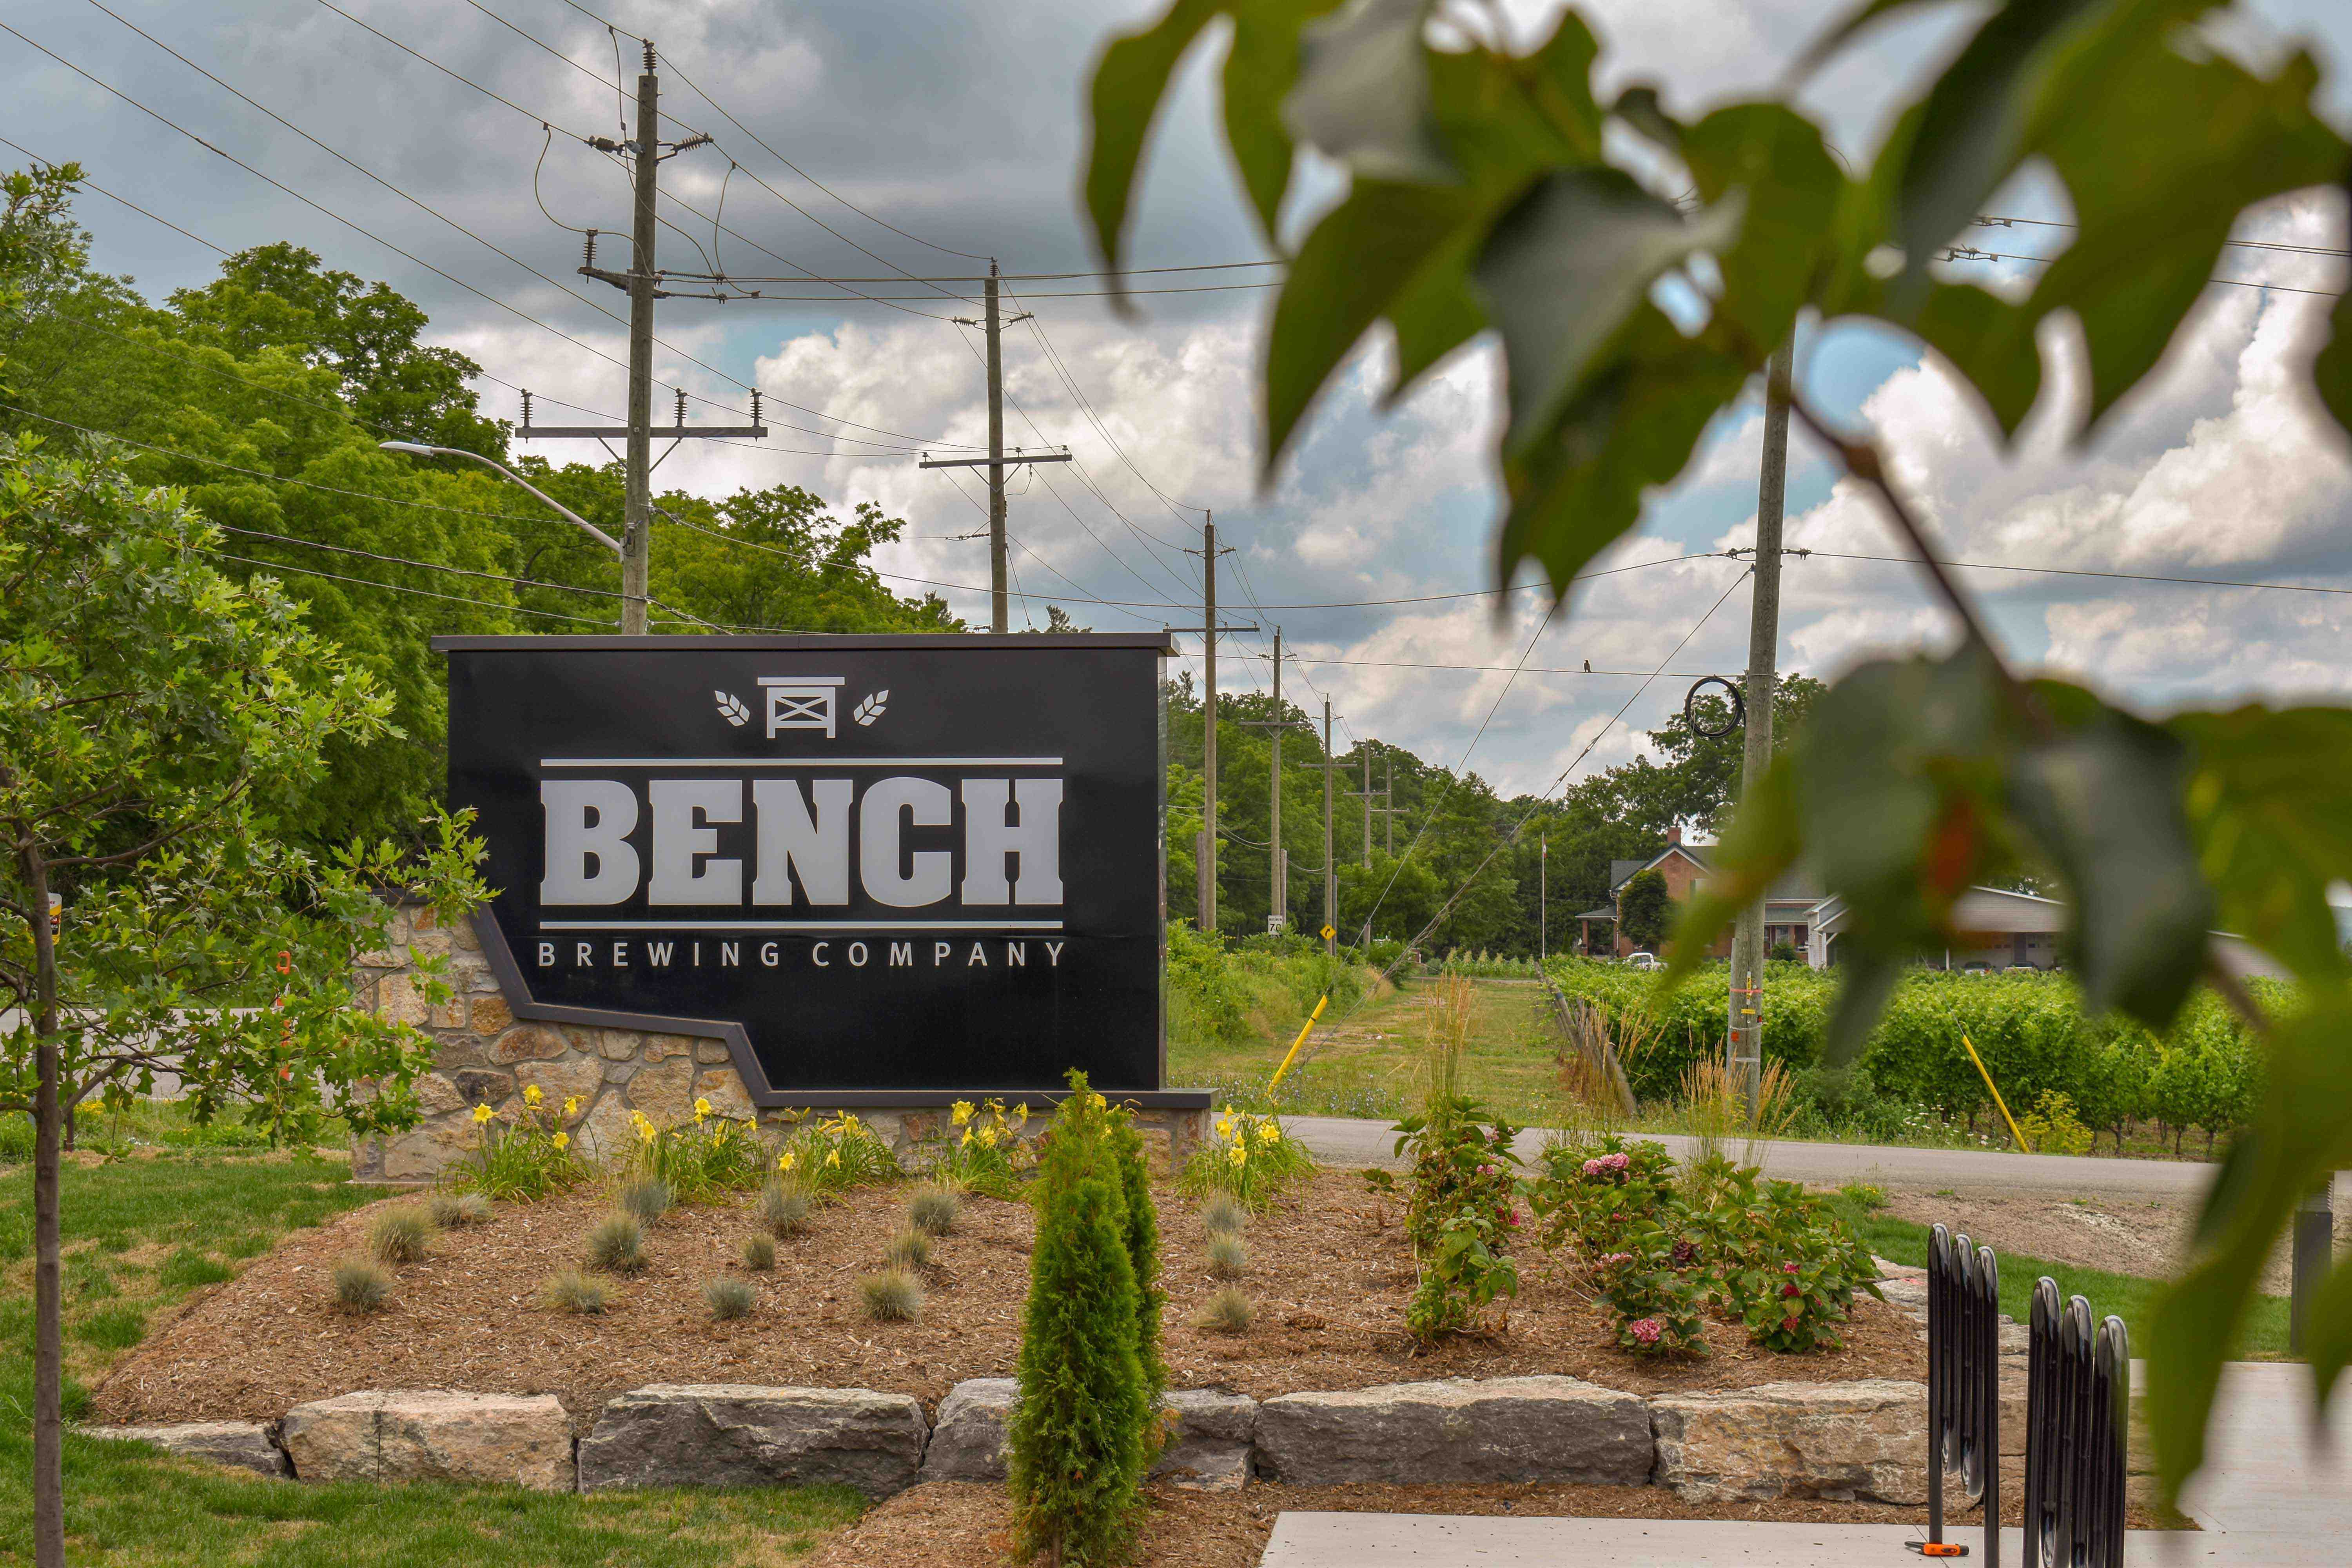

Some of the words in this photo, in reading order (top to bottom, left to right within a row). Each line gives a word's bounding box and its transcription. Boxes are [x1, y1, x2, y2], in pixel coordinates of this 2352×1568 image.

[540, 777, 1063, 907] BENCH
[1270, 924, 1281, 932] 70
[539, 942, 778, 966] BREWING
[813, 942, 1063, 966] COMPANY
